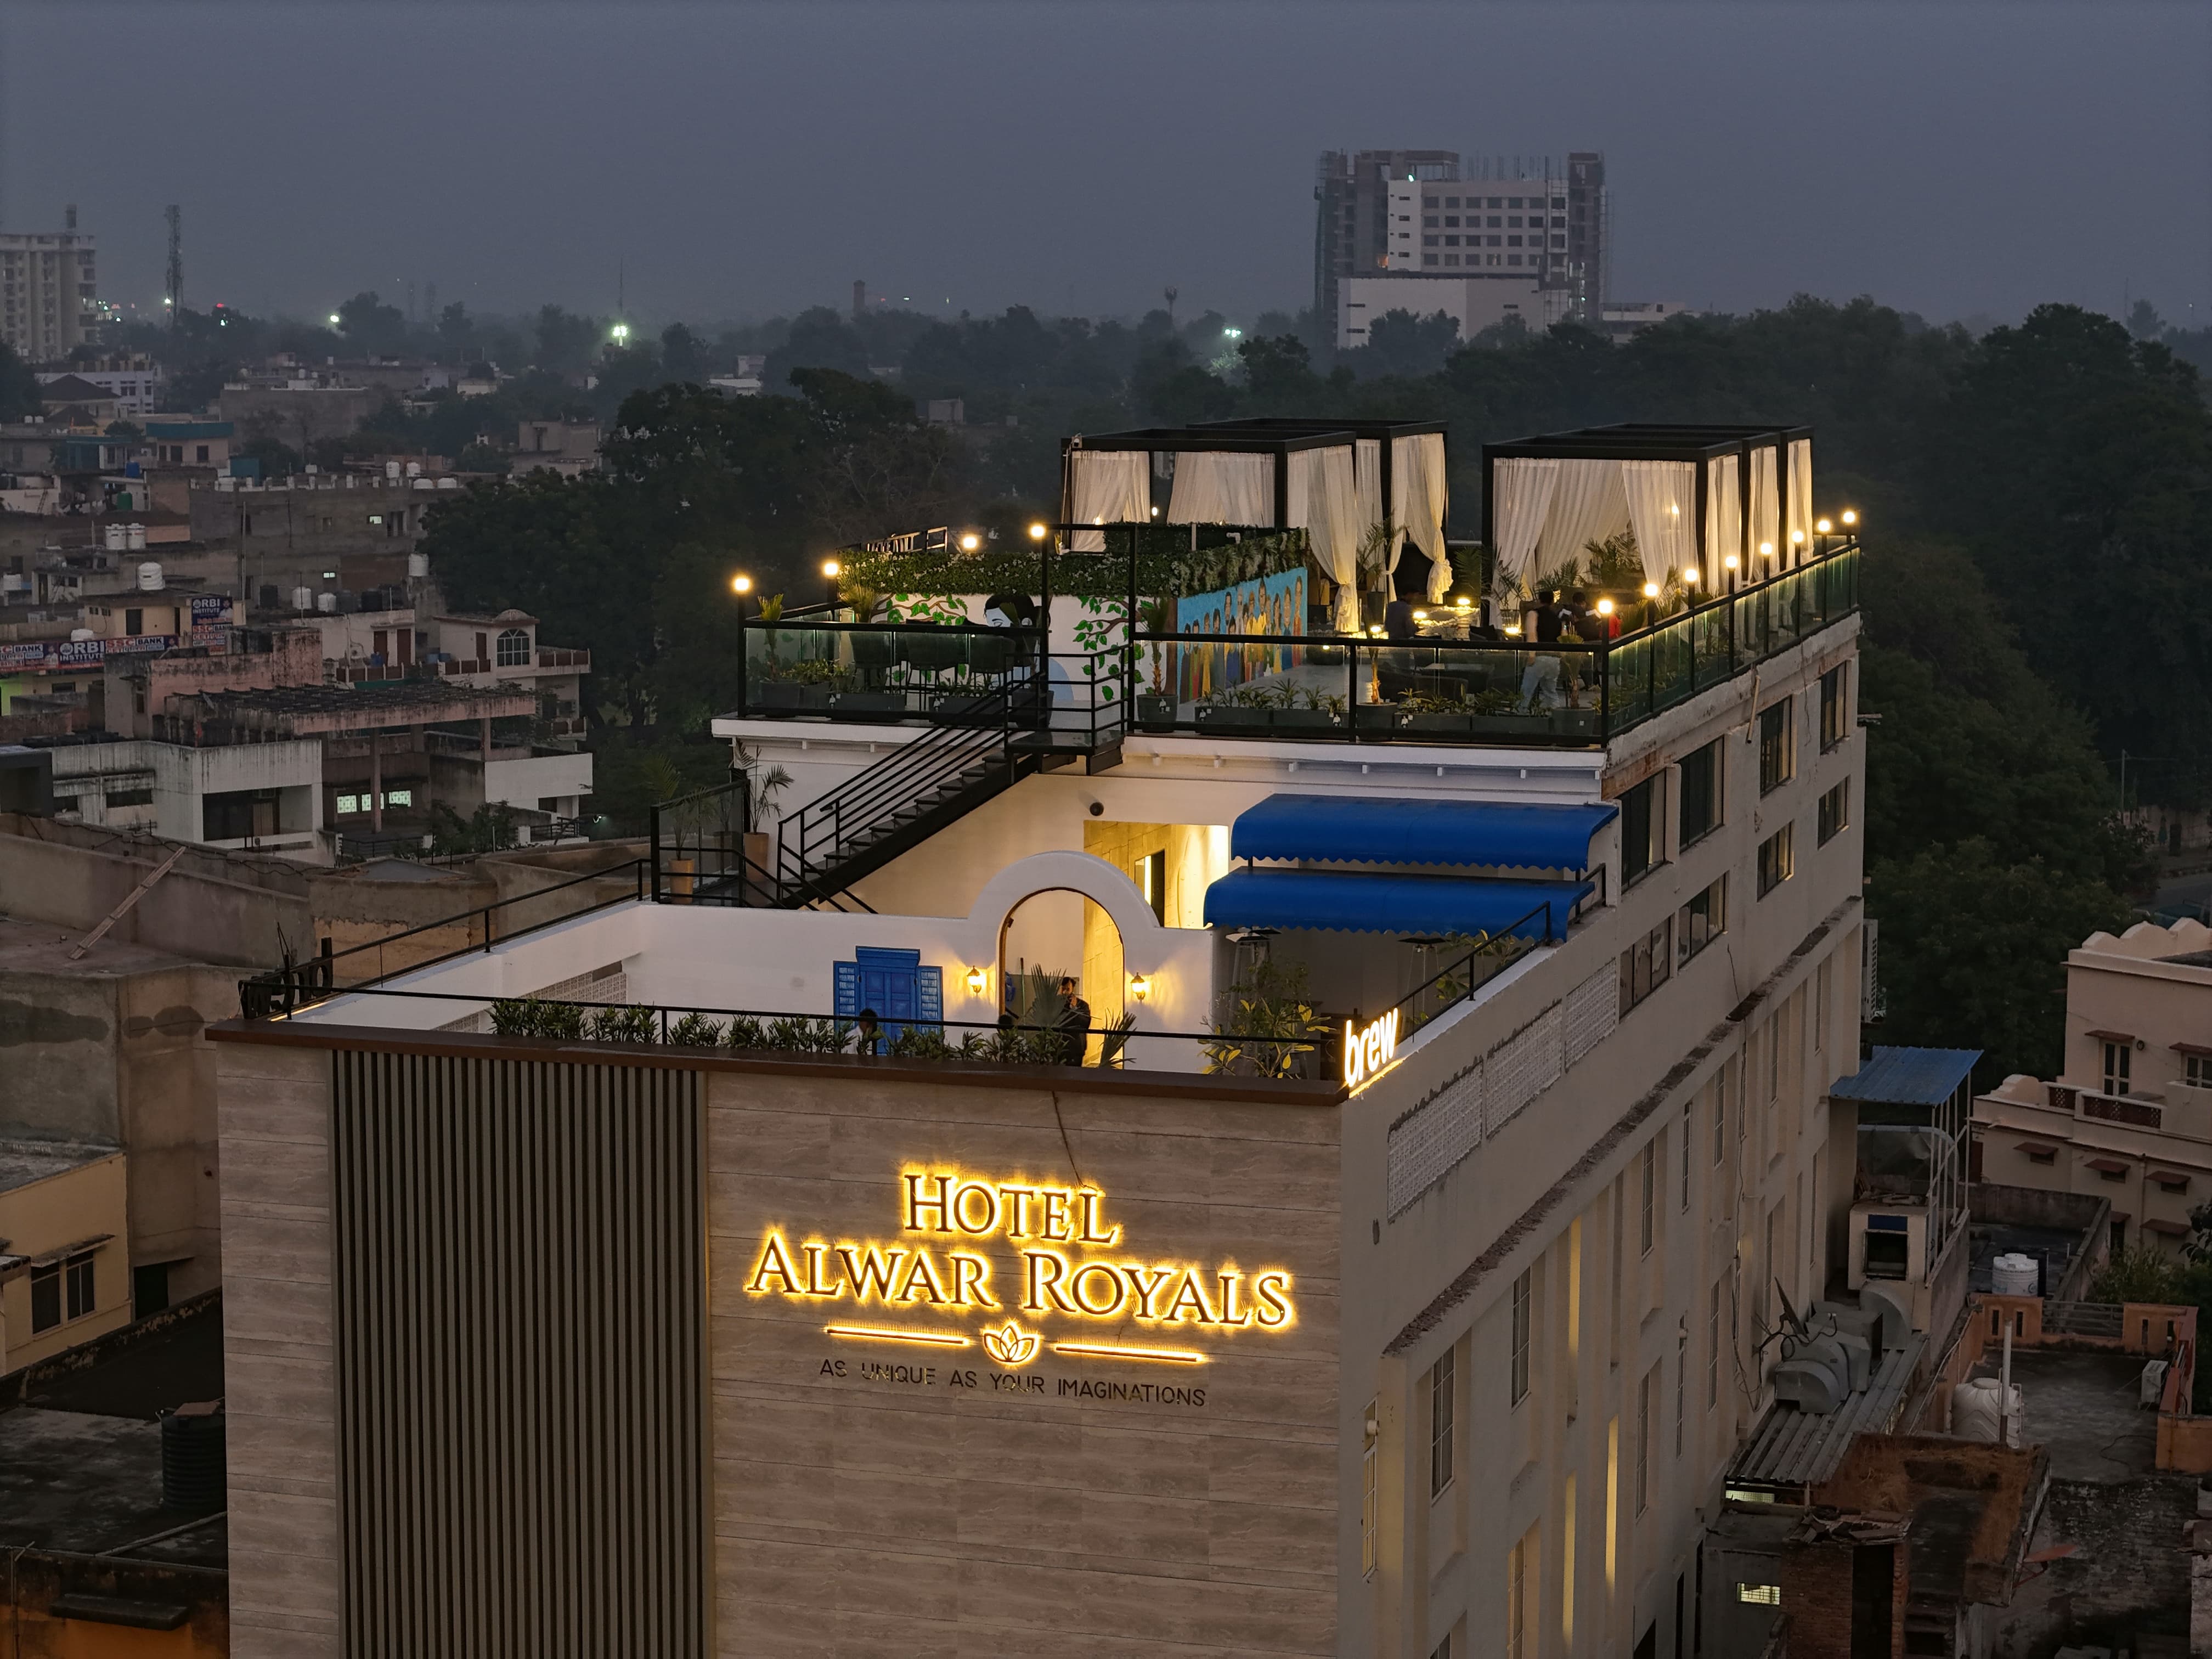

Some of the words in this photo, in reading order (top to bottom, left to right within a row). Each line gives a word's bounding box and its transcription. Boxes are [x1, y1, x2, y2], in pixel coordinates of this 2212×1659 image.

[60, 653, 104, 662] INSTITUTE
[106, 639, 135, 647] SSC
[1345, 1007, 1398, 1087] brew
[904, 1174, 1116, 1244] HOTEL
[749, 1235, 995, 1307] ALWAR
[1023, 1252, 1286, 1325] ROYALS
[820, 1358, 848, 1377] AS
[861, 1362, 936, 1385] UNIQUE
[950, 1369, 978, 1388] AS
[990, 1373, 1045, 1394] YOUR
[1058, 1378, 1206, 1407] IMAGINATIONS
